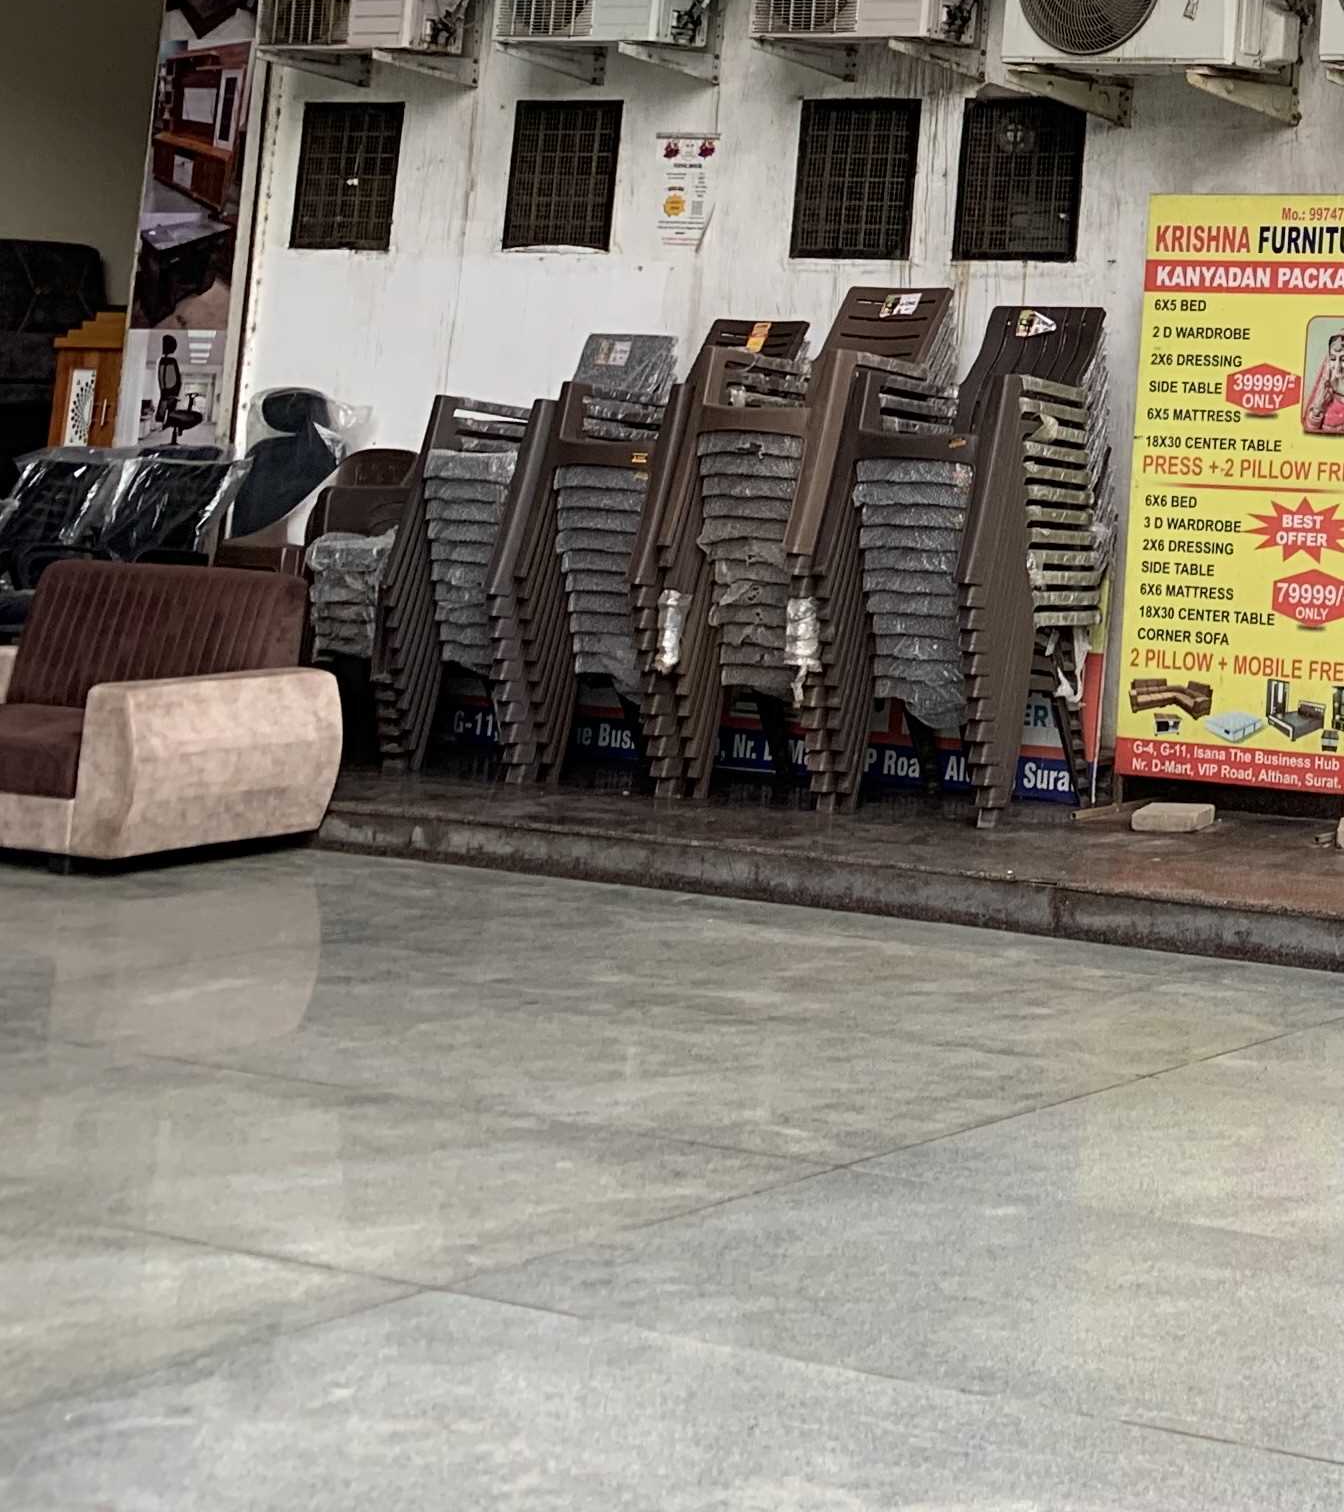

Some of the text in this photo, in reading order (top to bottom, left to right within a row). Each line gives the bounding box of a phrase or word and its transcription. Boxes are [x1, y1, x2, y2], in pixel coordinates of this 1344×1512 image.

[1309, 207, 1344, 221] 99747
[1155, 224, 1251, 254] KRISHNA
[1156, 265, 1271, 288] KANYADAN
[1180, 300, 1207, 312] BED
[1175, 327, 1251, 340] WARDROBE
[1176, 354, 1243, 368] DRESSING
[1148, 380, 1223, 395] SIDE TABLE
[1242, 393, 1284, 409] ONLY
[1172, 408, 1242, 423] MATTRESS
[1146, 435, 1282, 452] 18X30 CENTER TABLE
[1142, 454, 1204, 476] PRESS
[1239, 459, 1313, 481] PILLOW
[1282, 514, 1324, 530] BEST
[1275, 531, 1328, 547] OFFER
[1295, 606, 1329, 622] ONLY
[1137, 627, 1230, 646] CORNER SOFA
[1144, 649, 1214, 673] PILLOW
[1232, 655, 1303, 680] MOBILE
[1194, 741, 1226, 761] Isana
[1229, 745, 1252, 764] The
[1255, 748, 1312, 769] Business
[1314, 751, 1340, 771] Hub
[1023, 761, 1075, 793] Sura
[1132, 758, 1342, 790] Nr. D-Mart, VIP Road, Althan, Surat.
